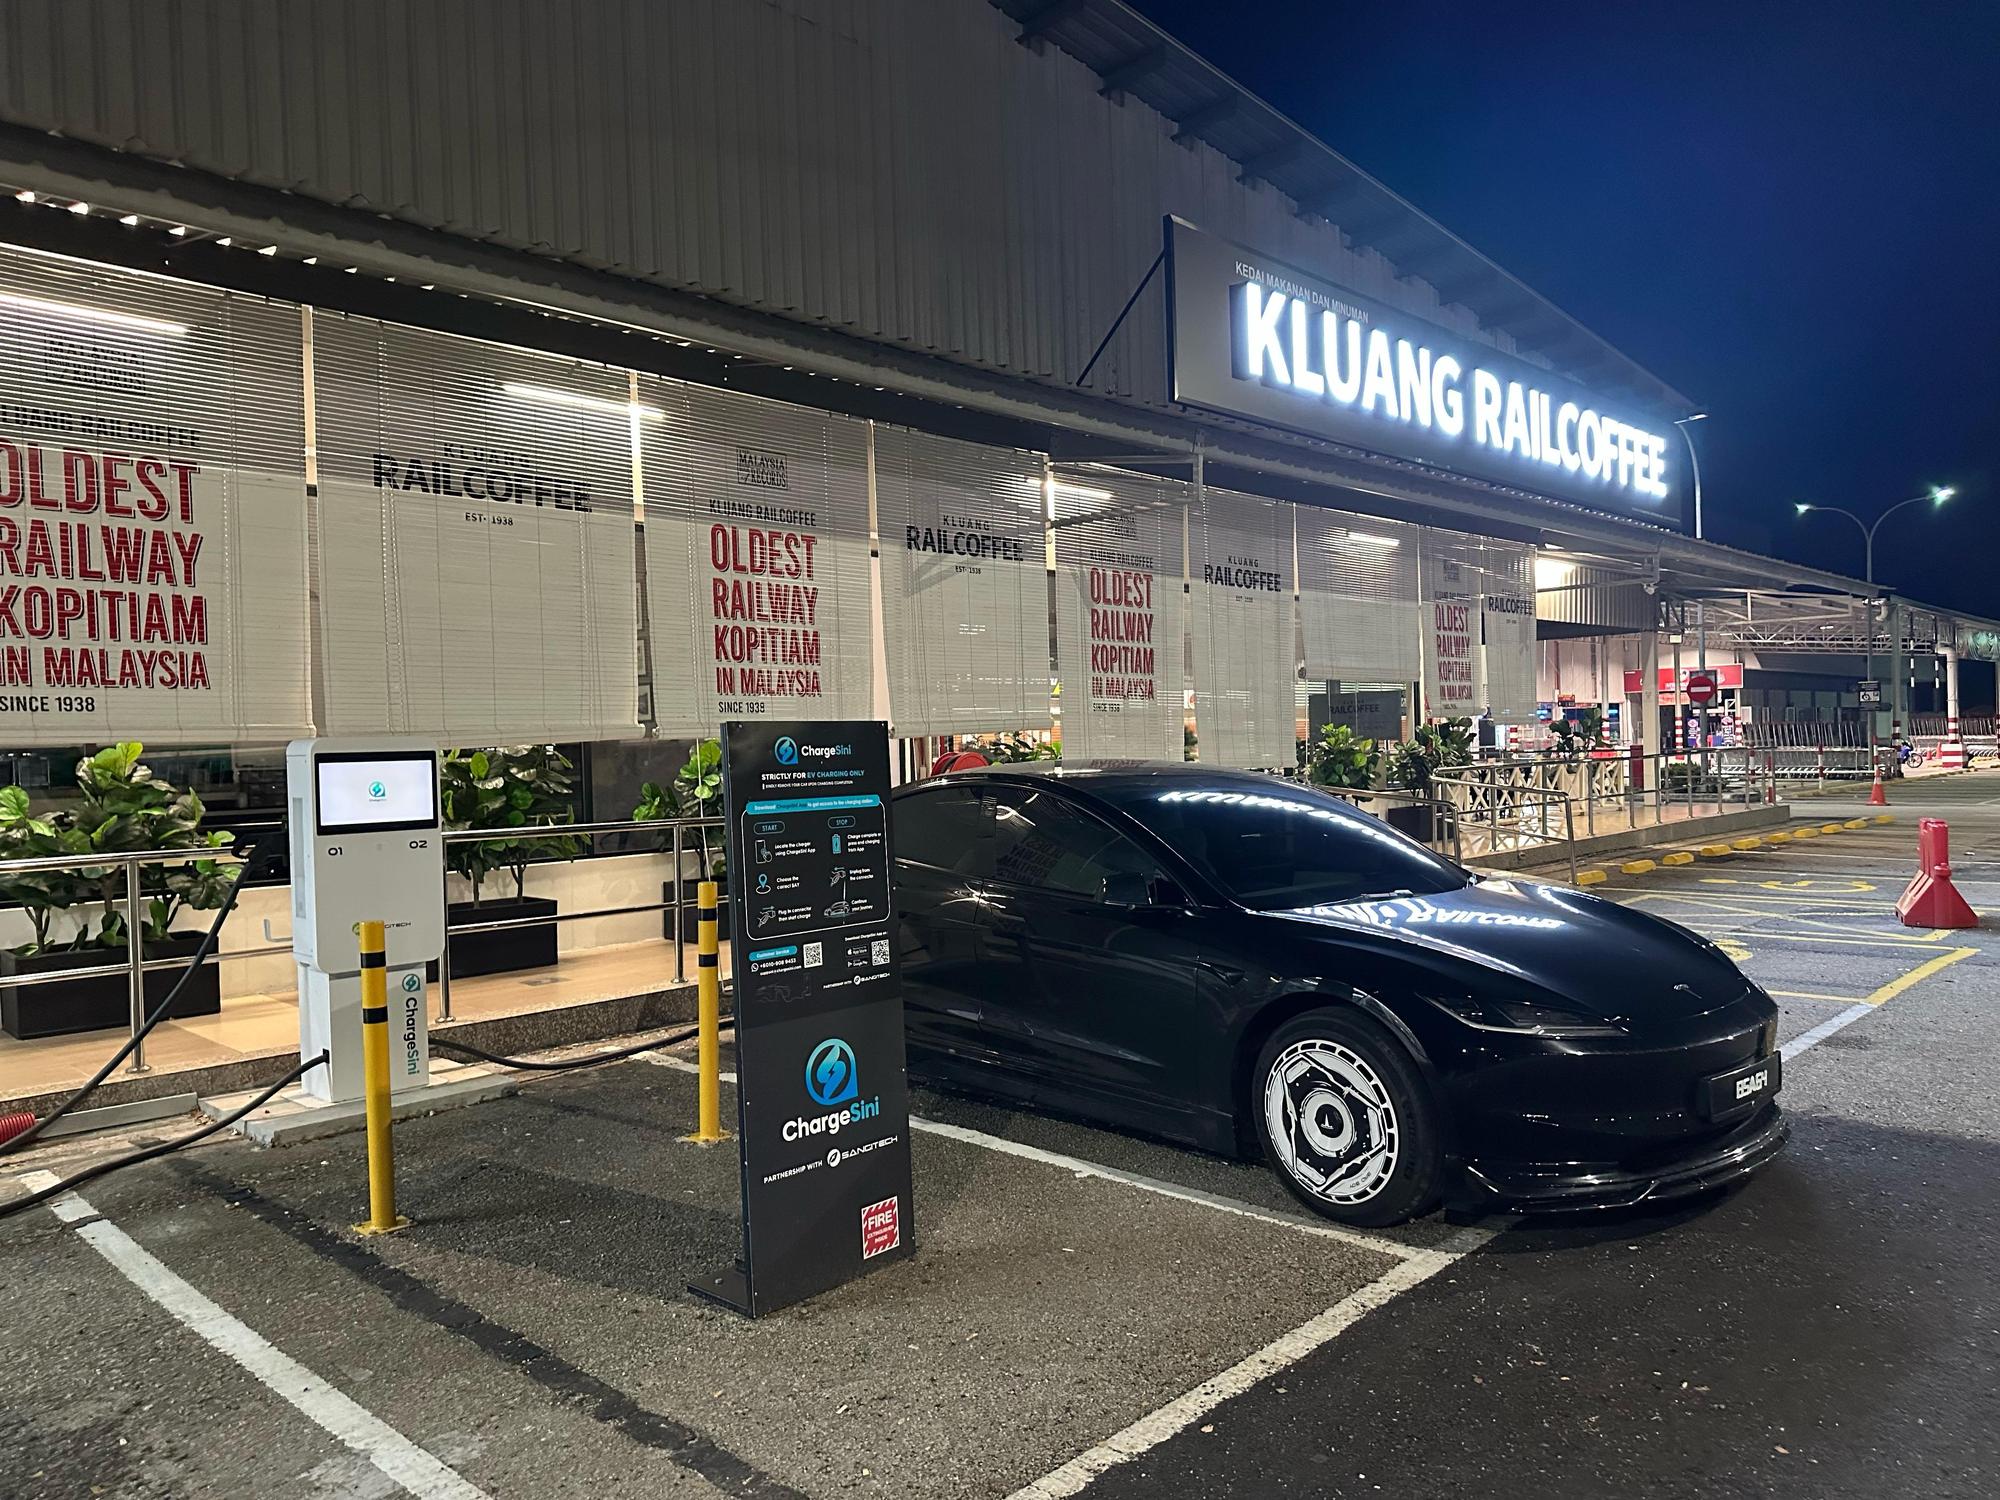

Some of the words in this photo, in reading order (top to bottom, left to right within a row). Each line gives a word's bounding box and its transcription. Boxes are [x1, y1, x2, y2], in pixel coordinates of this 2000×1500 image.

[1235, 261, 1264, 283] KEDAI
[1266, 273, 1311, 302] MAKANAN
[1312, 291, 1330, 309] DAN
[1331, 299, 1369, 324] MINUMAN
[1245, 281, 1463, 437] KLUANG
[1473, 367, 1668, 499] RAILCOFFEE
[0, 404, 73, 431] LUANG
[443, 443, 531, 468] KLUANG
[0, 437, 201, 524] OLDEST
[372, 453, 593, 513] RAILCOFFEE
[491, 515, 514, 526] 1938
[709, 499, 753, 519] KLUANG
[756, 505, 817, 527] RAILCOFFEE
[943, 515, 990, 531] KLUANG
[0, 516, 203, 587] RAILWAY
[710, 523, 817, 580] OLDEST
[906, 525, 1024, 561] RAILCOFFEE
[1228, 555, 1259, 567] KLUANG
[1090, 567, 1153, 609] OLDEST
[1204, 564, 1282, 592] RAILCOFFEE
[0, 583, 208, 645] KOPITIAM
[712, 577, 819, 625] RAILWAY
[1488, 596, 1533, 615] RAILCOFFEE
[1091, 608, 1154, 644] RAILWAY
[1435, 603, 1470, 632] OLDEST
[714, 624, 822, 666] KOPITIAM
[1436, 634, 1471, 658] RAILWAY
[44, 647, 210, 690] MALAYSIA
[1091, 643, 1155, 677] KOPITIAM
[716, 667, 736, 696] IN
[740, 667, 822, 697] MALAYSIA
[1092, 677, 1103, 698] IN
[1105, 677, 1155, 700] MALAYSIA
[0, 696, 50, 713] SINCE
[56, 697, 95, 713] 1938
[718, 701, 743, 713] SINCE
[745, 702, 765, 713] 1938
[801, 744, 851, 758] ChargeSini
[761, 773, 792, 781] STRICTLY
[792, 772, 806, 780] FOR
[807, 771, 816, 779] EV
[816, 770, 848, 778] CHARGING
[849, 769, 865, 777] ONLY
[762, 824, 778, 832] START
[404, 997, 420, 1075] ChargeSini
[782, 1096, 880, 1142] ChargeSini
[763, 1165, 806, 1184] PARTNERSHIP
[806, 1160, 823, 1171] WITH
[868, 1209, 893, 1231] FIRE
